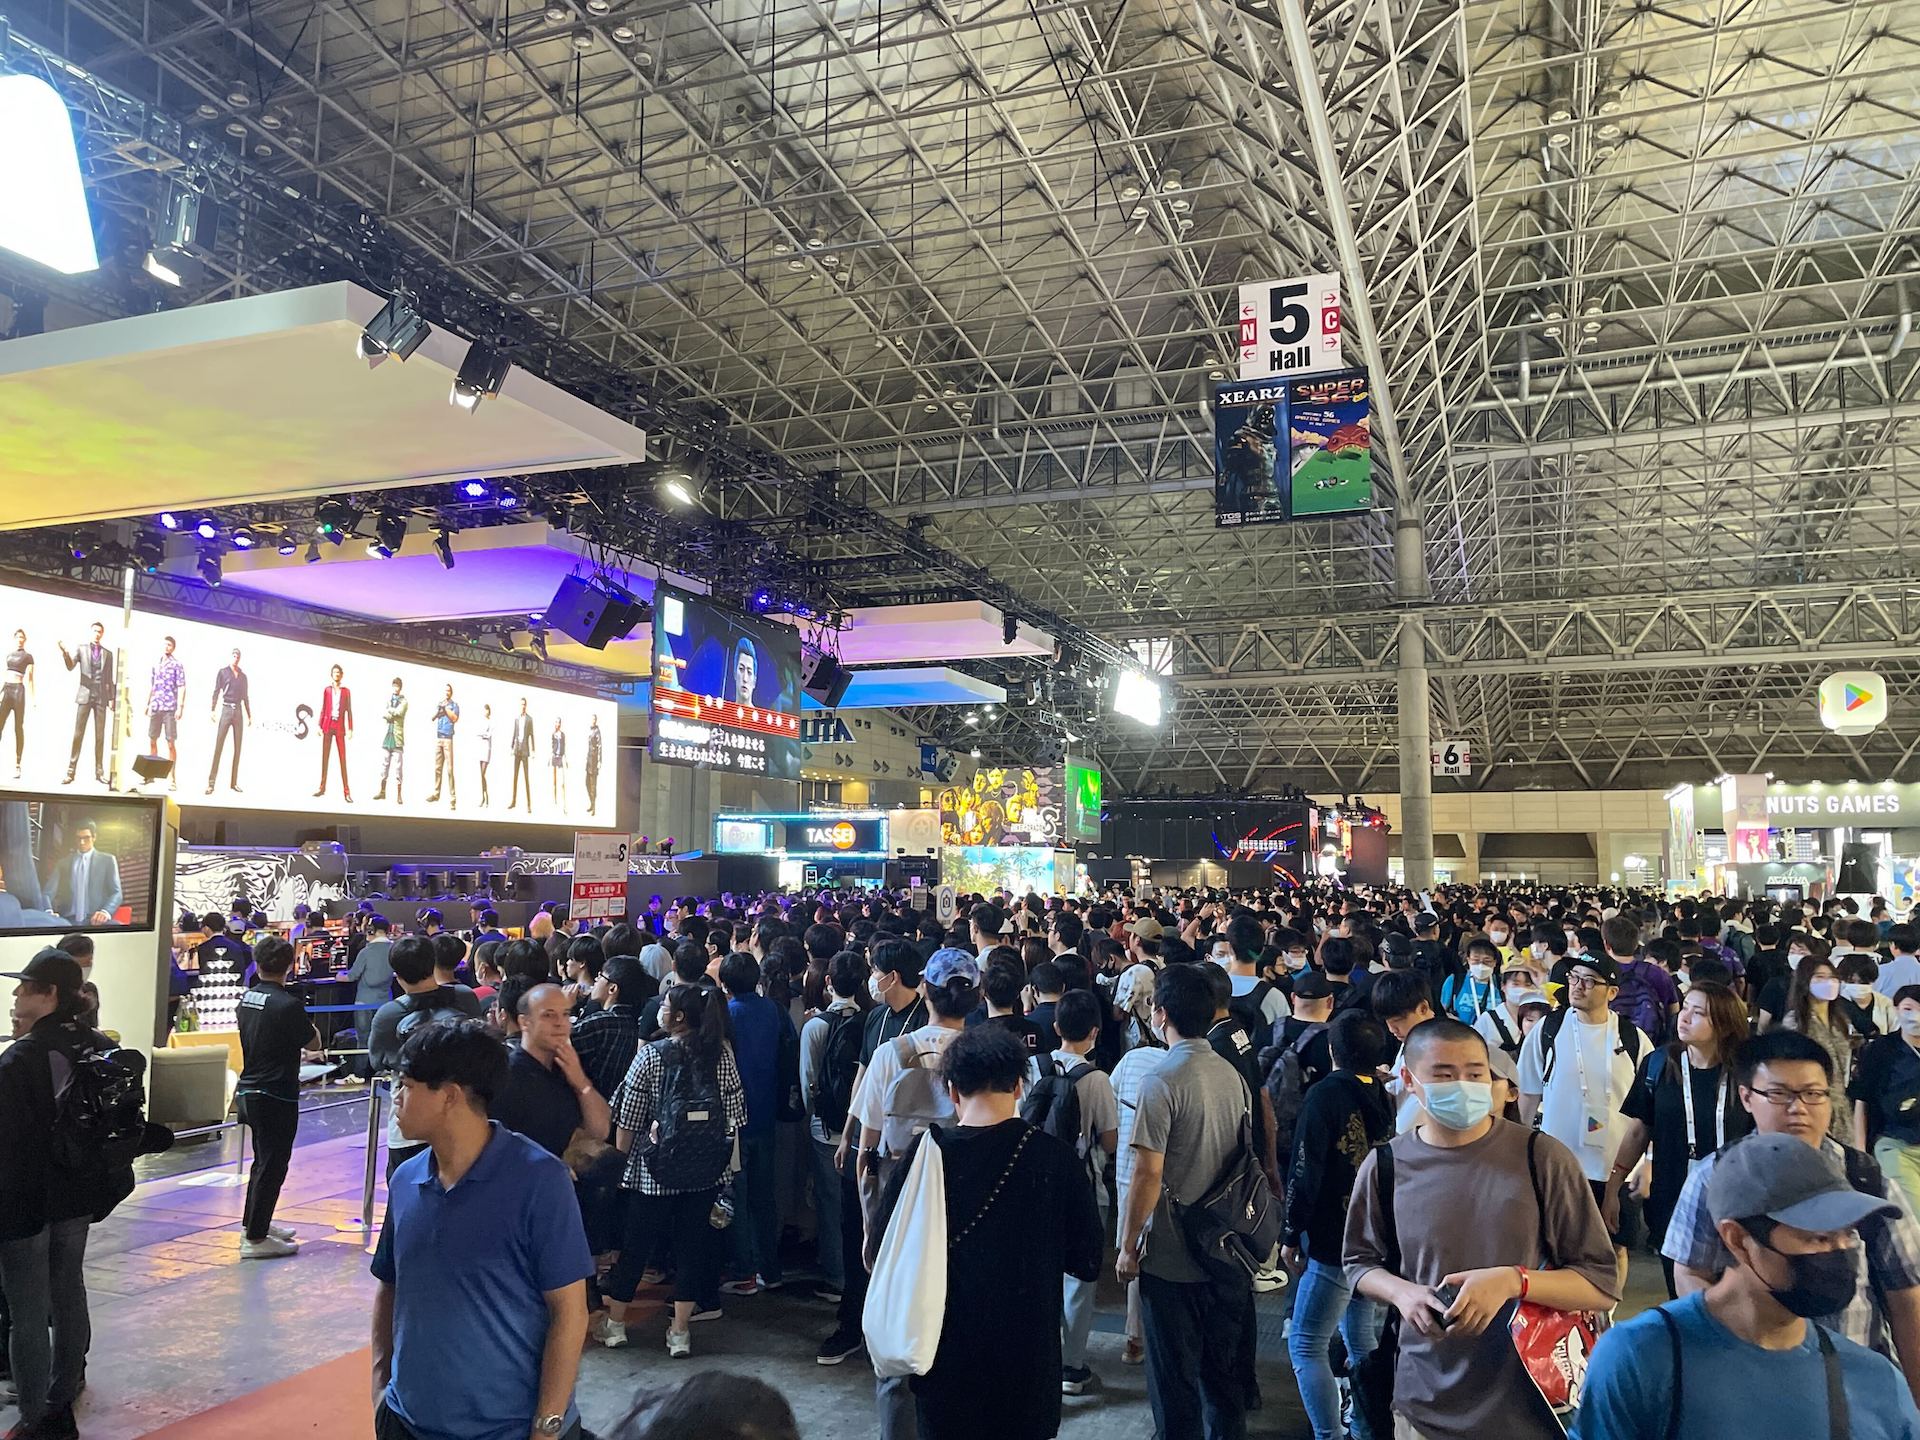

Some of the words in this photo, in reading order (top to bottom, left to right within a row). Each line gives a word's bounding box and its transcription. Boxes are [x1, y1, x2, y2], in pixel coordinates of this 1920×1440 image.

[1270, 283, 1310, 345] 5
[1325, 311, 1338, 330] C
[1242, 323, 1256, 341] N
[1270, 346, 1311, 371] Hall
[1219, 386, 1285, 405] XEARZ
[1297, 378, 1365, 396] SUPER
[1444, 745, 1459, 765] 6
[1826, 795, 1900, 813] GAMES
[1767, 876, 1809, 886] AGATHA
